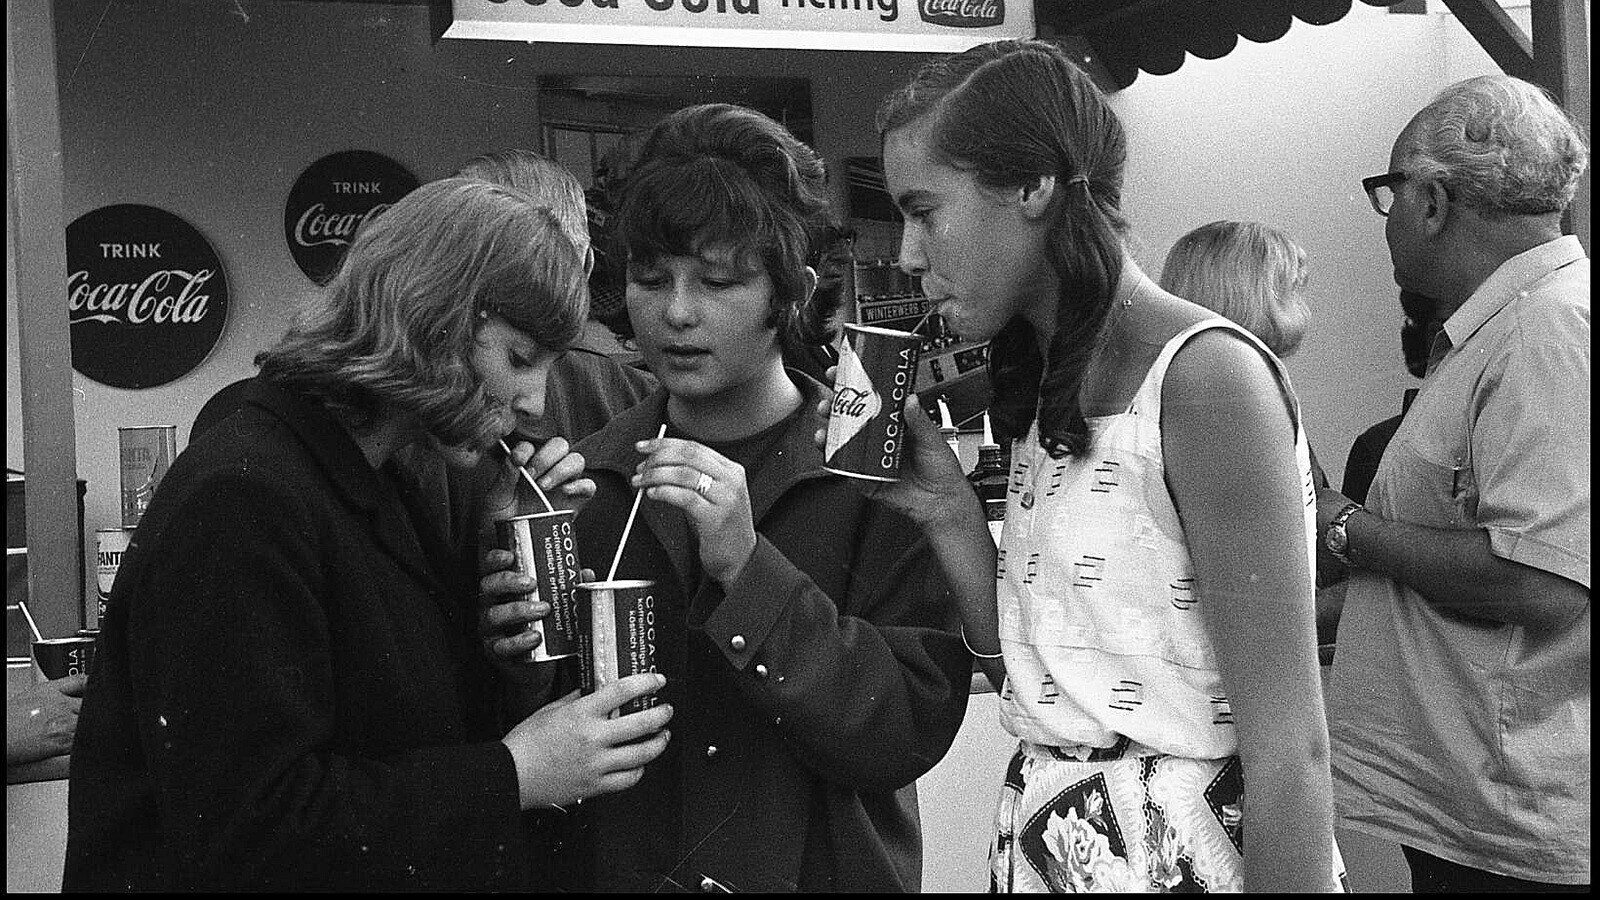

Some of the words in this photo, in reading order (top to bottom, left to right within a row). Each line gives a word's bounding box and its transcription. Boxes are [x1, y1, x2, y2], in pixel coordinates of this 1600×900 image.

[332, 182, 382, 194] TRINK
[100, 243, 162, 258] TRINK
[866, 303, 919, 320] WINTERWERB
[881, 348, 911, 470] COCA-COLA
[97, 551, 122, 566] FANT
[544, 537, 556, 577] köstlich
[552, 524, 567, 591] koffeinhaltige
[549, 578, 563, 632] erfrischend
[628, 610, 638, 649] köstlich
[637, 598, 647, 666] koffeinhaltige
